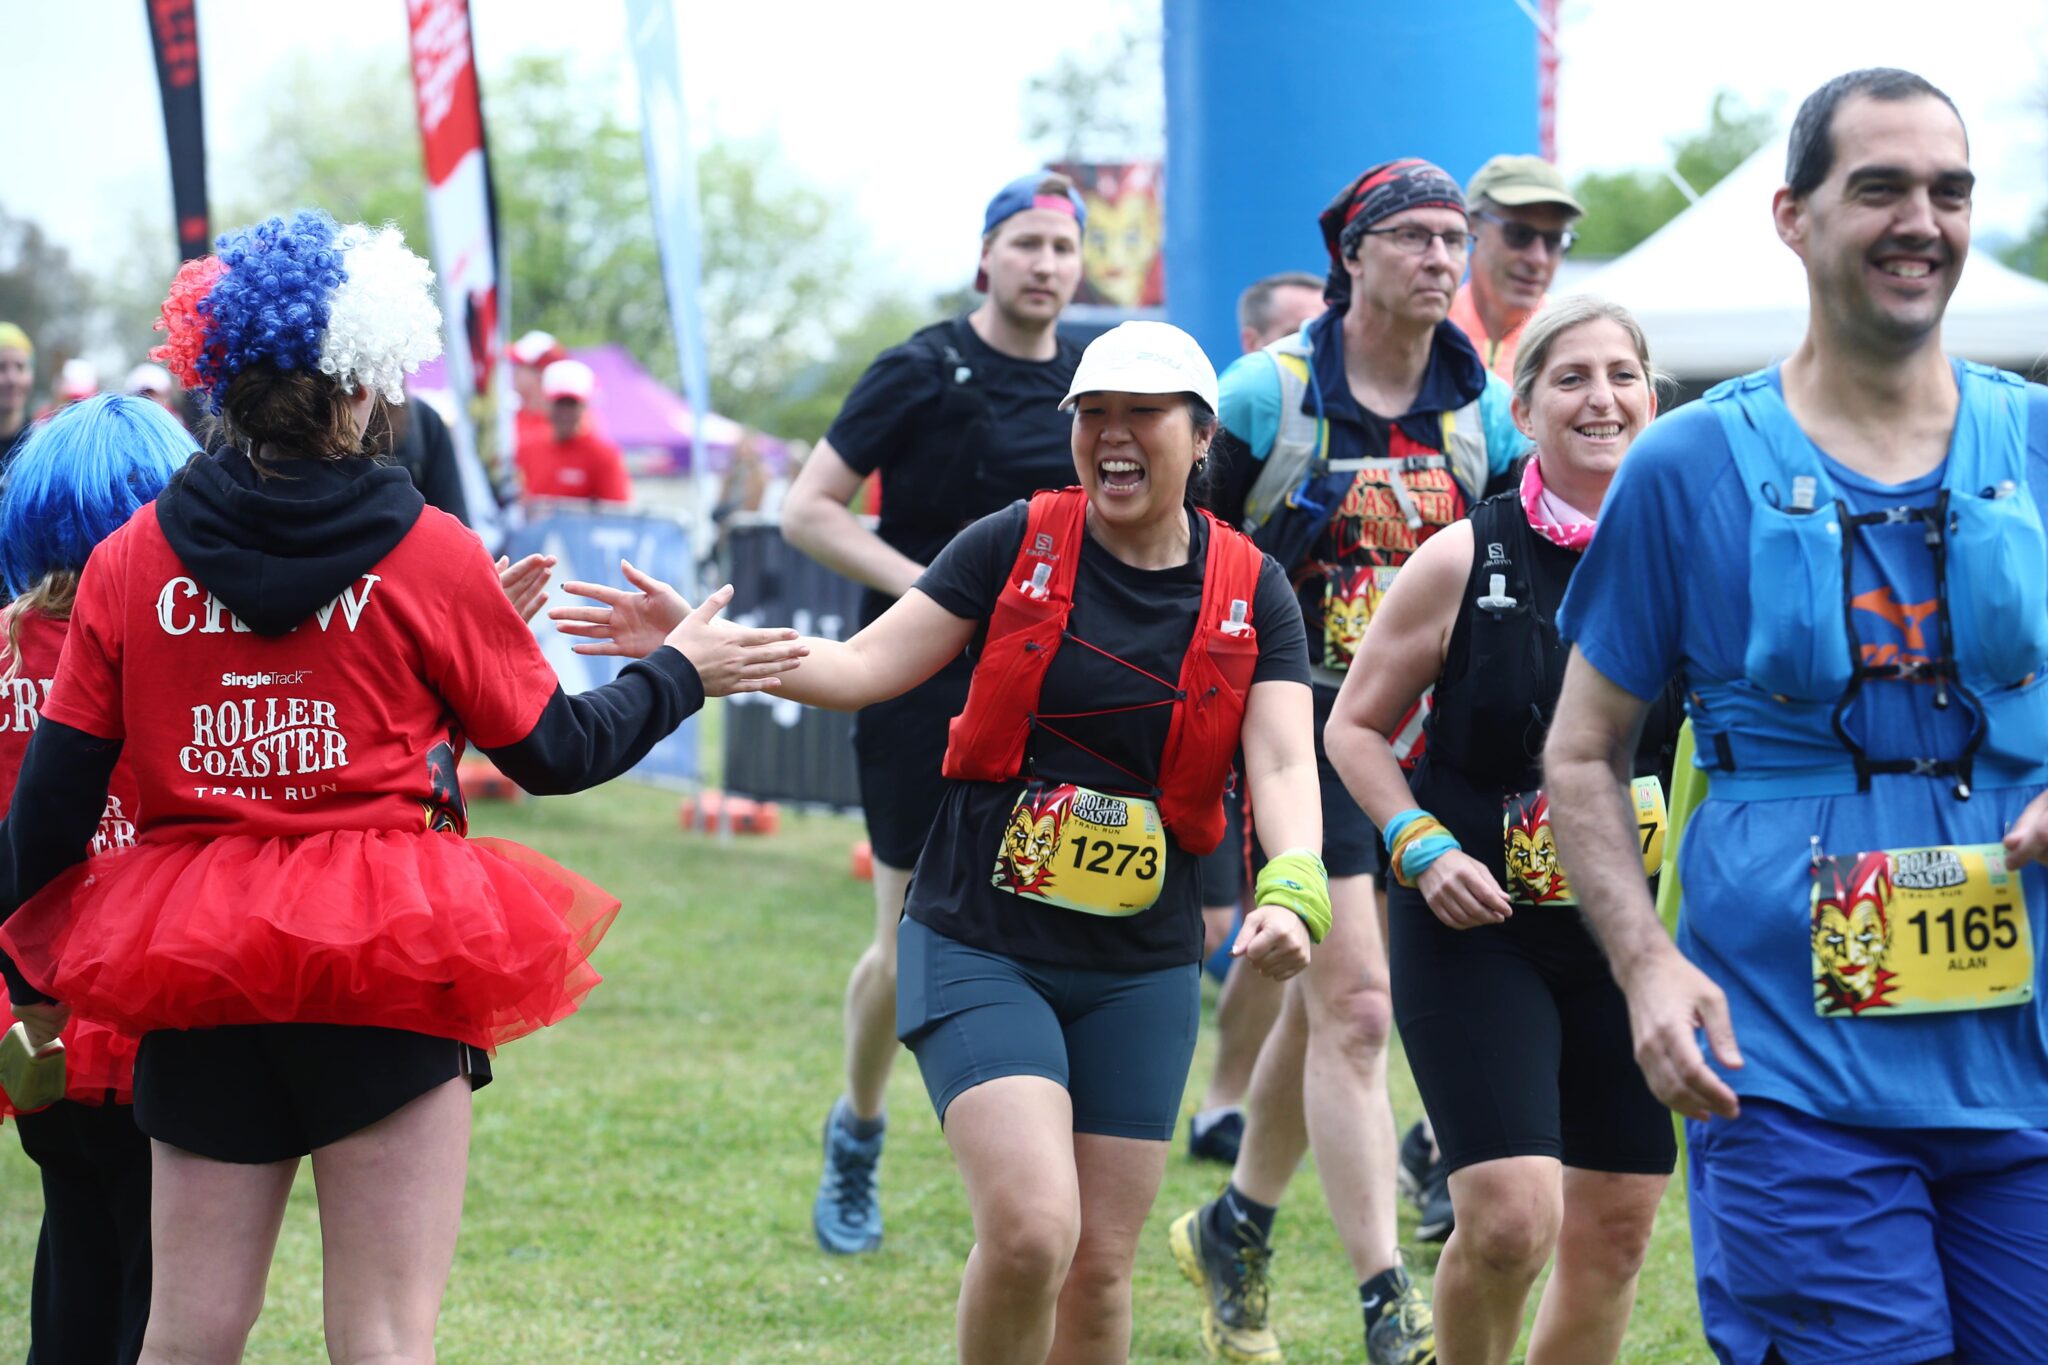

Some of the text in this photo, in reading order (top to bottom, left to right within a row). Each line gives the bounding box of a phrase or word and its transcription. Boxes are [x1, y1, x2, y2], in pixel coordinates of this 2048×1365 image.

[1360, 518, 1418, 552] RUN
[155, 574, 381, 635] CRW
[221, 670, 303, 689] SingleTrack
[191, 697, 339, 747] ROLLER
[179, 727, 349, 777] COASTER
[194, 783, 337, 800] TRAIL RUN
[1079, 793, 1126, 813] ROLLER
[1072, 804, 1127, 825] COASTER
[1074, 819, 1098, 832] TRAIL
[1071, 836, 1158, 880] 1273
[1898, 851, 1958, 875] ROLLER
[1893, 864, 1967, 888] COASTER
[1908, 903, 2018, 954] 1165
[1948, 957, 1987, 971] ALAN
